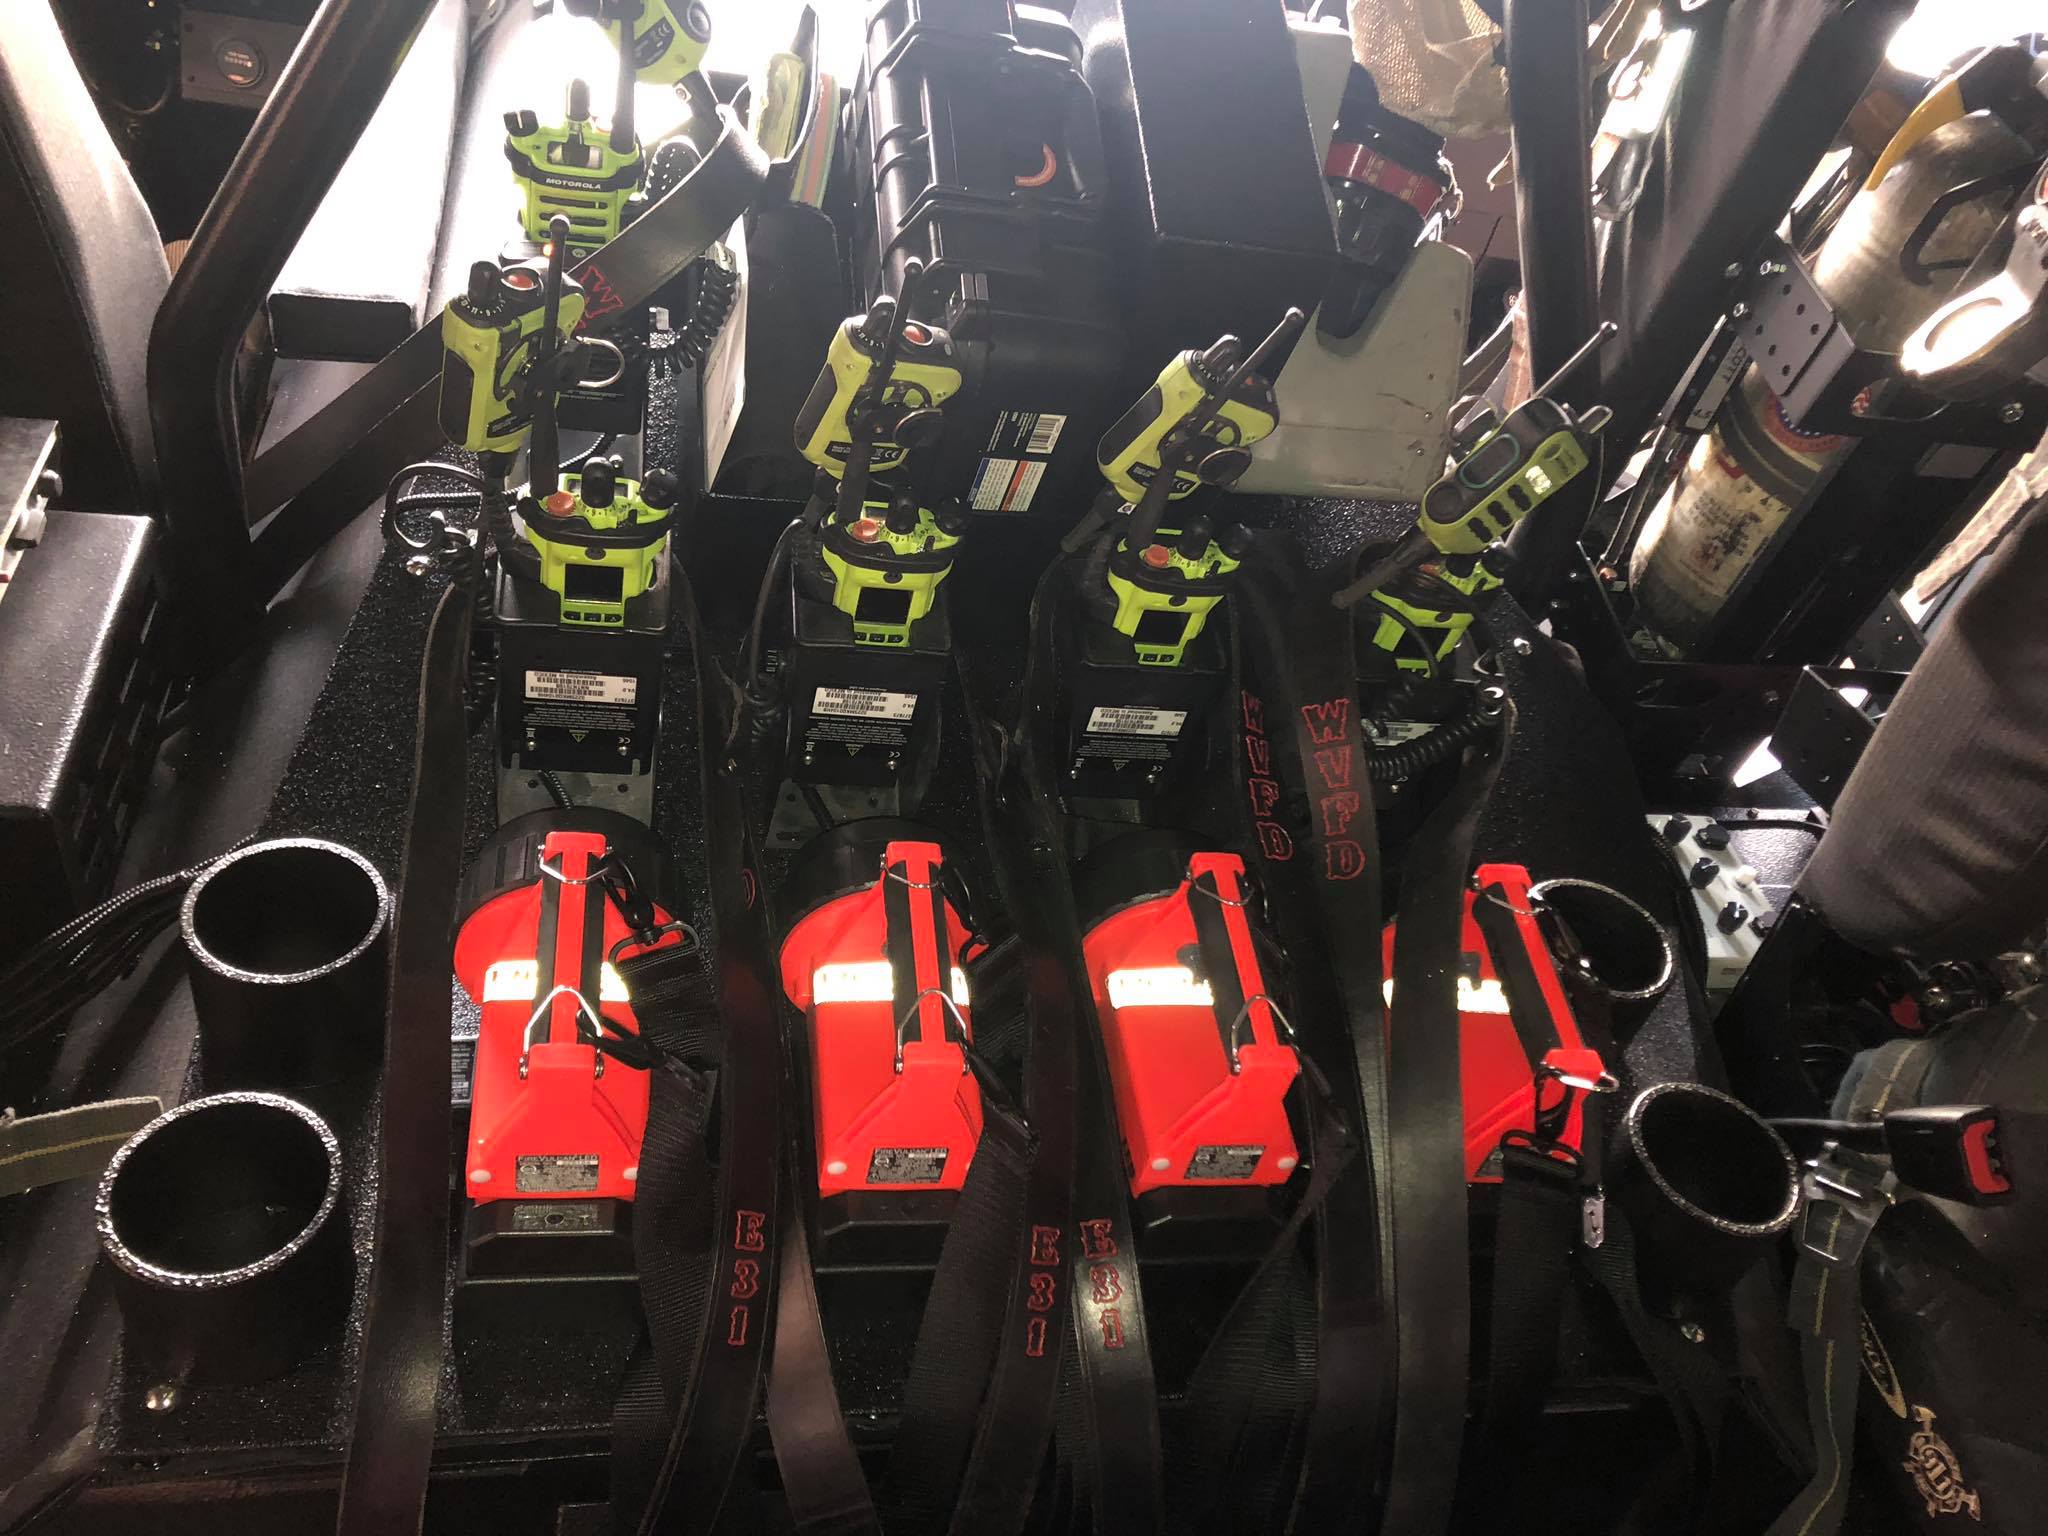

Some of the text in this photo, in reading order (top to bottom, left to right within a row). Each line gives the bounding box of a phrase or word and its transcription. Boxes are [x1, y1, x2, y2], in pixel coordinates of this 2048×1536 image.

[545, 177, 601, 190] MOTOROLA
[1301, 697, 1366, 880] WVFD
[727, 1209, 766, 1347] E31
[1026, 1224, 1061, 1358] E31
[1080, 1217, 1125, 1349] E31
